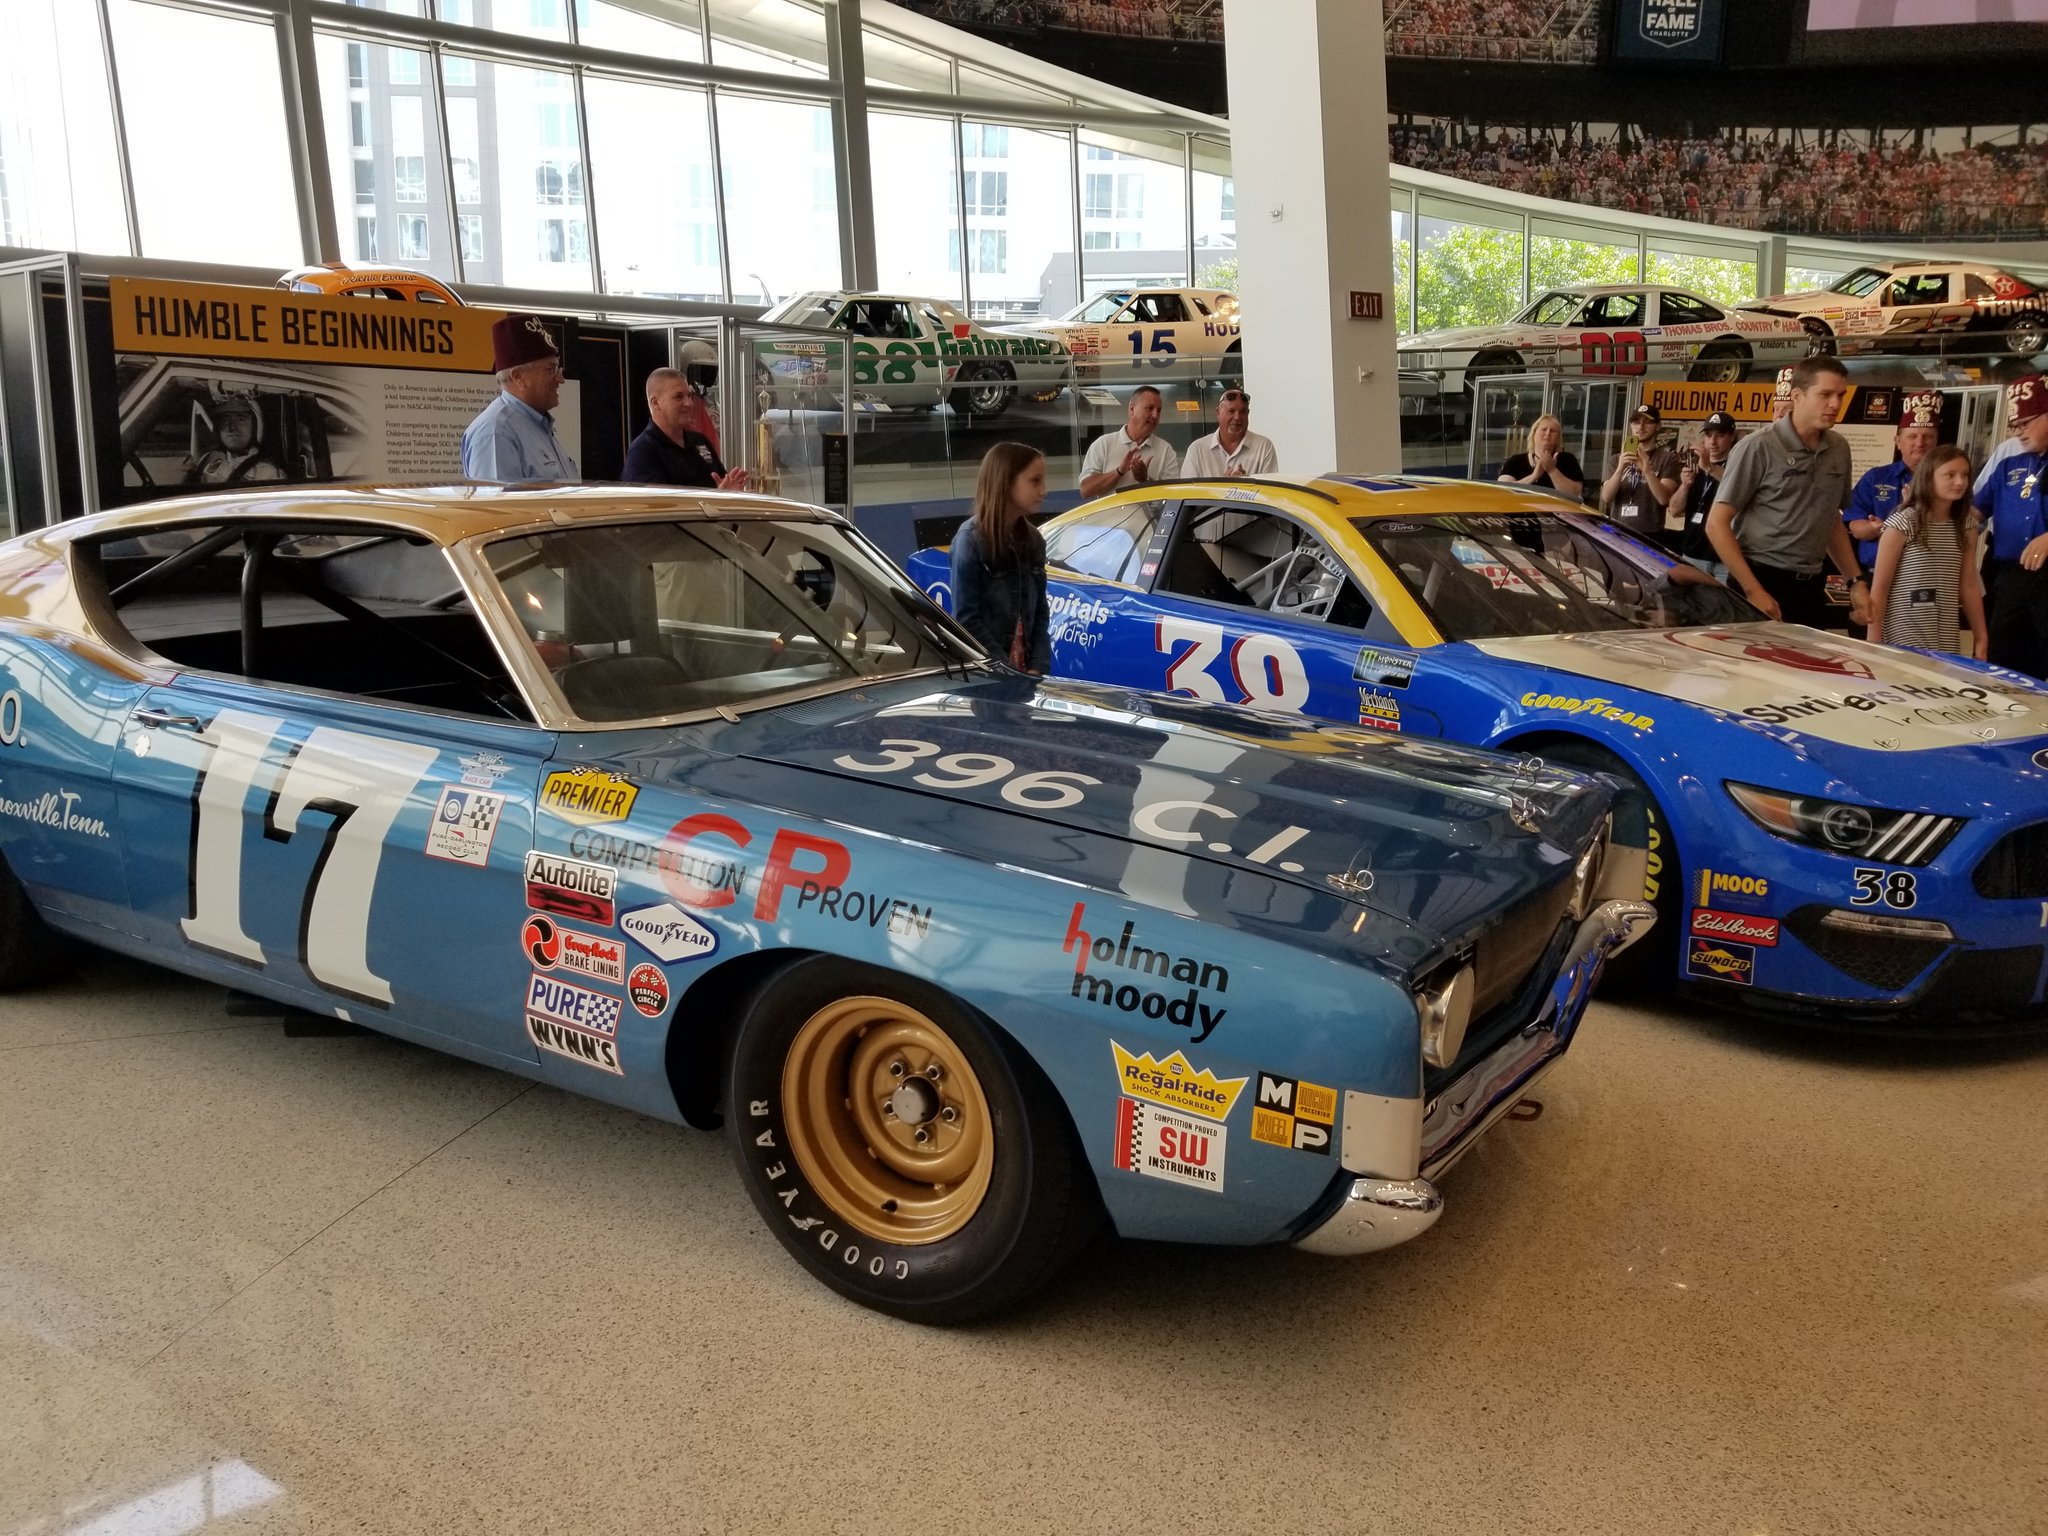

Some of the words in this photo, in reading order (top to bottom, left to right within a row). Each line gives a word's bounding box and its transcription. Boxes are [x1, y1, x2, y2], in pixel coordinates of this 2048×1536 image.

[1646, 13, 1695, 29] FAME
[340, 273, 379, 285] Richie
[380, 273, 415, 283] Evans
[1355, 295, 1378, 316] EXIT
[134, 295, 269, 343] HUMBLE
[281, 306, 454, 355] BEGINNINGS
[1662, 324, 1703, 337] THOMAS
[1704, 322, 1733, 334] BROS.
[1736, 320, 1773, 333] COUNTRY
[1782, 320, 1801, 333] HAM
[1128, 329, 1177, 368] 15
[848, 341, 917, 384] 88
[384, 383, 397, 391] Only
[448, 386, 466, 394] dream
[445, 395, 469, 403] Childress
[1654, 390, 1728, 412] BUILDING
[1734, 392, 1744, 412] A
[385, 402, 399, 410] place
[407, 402, 432, 410] NASCAR
[433, 404, 451, 412] history
[385, 420, 400, 428] From
[401, 421, 430, 430] competing
[386, 429, 411, 437] Childress
[412, 430, 423, 438] first
[386, 440, 412, 448] inaugural
[413, 439, 438, 447] Talladega
[387, 448, 401, 456] shop
[387, 458, 412, 466] mainstay
[1224, 487, 1260, 501] David
[1388, 523, 1416, 532] Ford
[1377, 655, 1412, 668] MONSTER
[1359, 686, 1400, 712] Mechanix
[1521, 691, 1655, 732] GOODYEAR
[1742, 690, 1907, 724] Shriers
[1361, 706, 1398, 718] WEAR
[479, 777, 491, 785] CAR
[833, 739, 1103, 809] 396
[546, 780, 628, 818] PREMIER
[180, 707, 440, 1010] 17
[436, 843, 461, 852] RECORD
[463, 847, 479, 856] CLUB
[569, 829, 747, 896] COMPETITION
[530, 858, 610, 897] Autolite
[1713, 873, 1768, 897] MOOG
[1850, 867, 1917, 909] 38
[797, 880, 933, 939] PROVEN
[625, 917, 710, 948] GOODYEAR
[1693, 913, 1776, 941] Edelbrock
[1062, 902, 1229, 993] holman
[564, 952, 590, 971] BRAKE
[593, 959, 619, 979] LINING
[1694, 952, 1750, 972] SUNOCO
[531, 978, 588, 1022] PURE
[635, 988, 661, 1001] PERFECT
[637, 996, 659, 1007] CIRCLE
[1071, 971, 1228, 1044] moody
[529, 1016, 617, 1068] WYNN'S
[1131, 1083, 1161, 1097] SHOCK
[1165, 1093, 1216, 1113] ABSORBERS
[1154, 1112, 1193, 1131] COMPETITION
[1194, 1124, 1218, 1137] PROVED
[1159, 1126, 1209, 1166] SW
[1148, 1155, 1217, 1182] INSTRUMENTS
[750, 1100, 909, 1280] GOODYEAR
